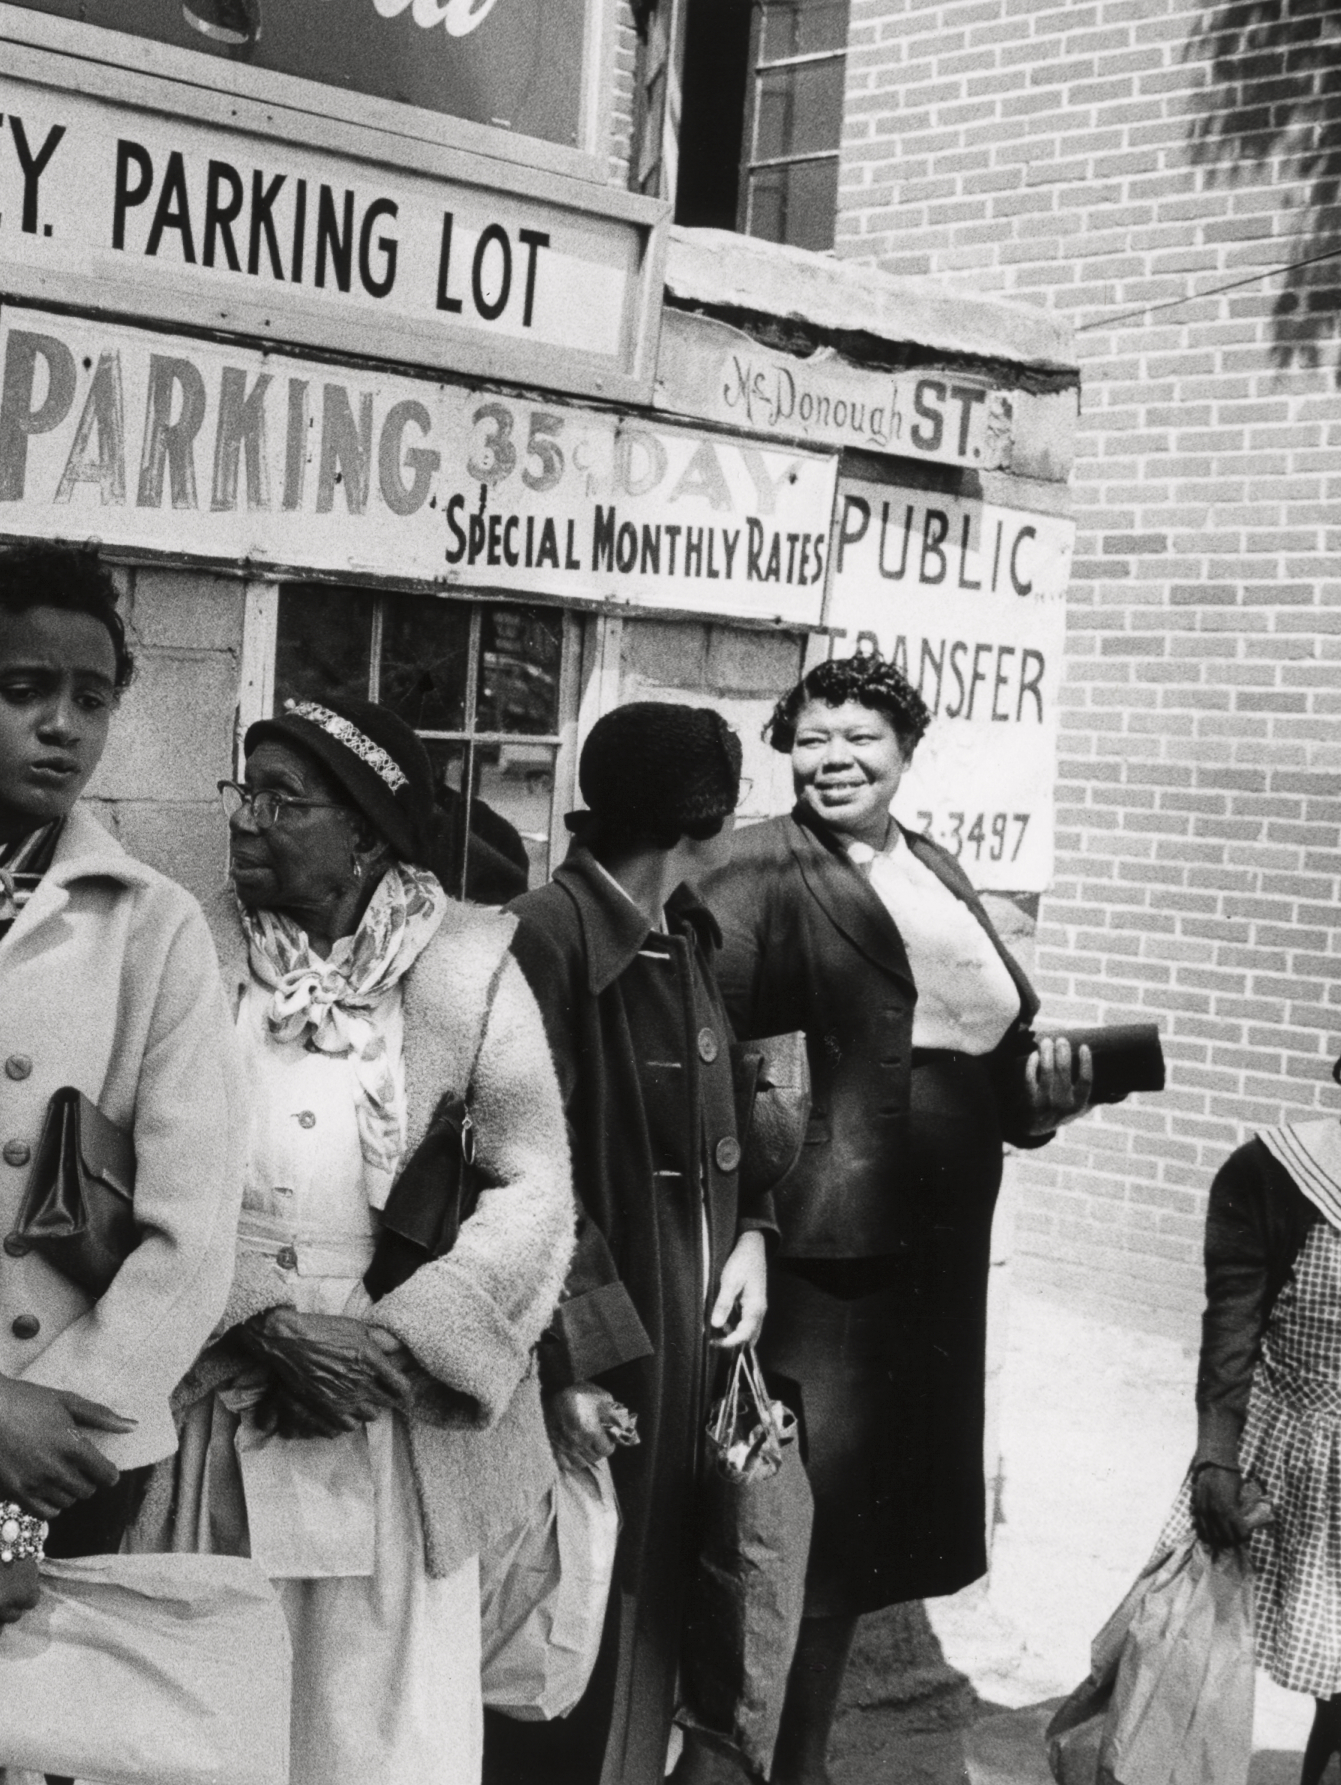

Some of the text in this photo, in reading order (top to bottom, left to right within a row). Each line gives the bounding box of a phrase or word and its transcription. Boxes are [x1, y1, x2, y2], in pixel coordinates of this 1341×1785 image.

[111, 137, 399, 300] PARKING
[435, 210, 551, 328] LOT
[910, 378, 987, 458] ST.
[614, 425, 809, 516] DAY
[445, 493, 826, 586] SPECIAL MONTHLY RATES
[836, 495, 1037, 596] PUBLIC
